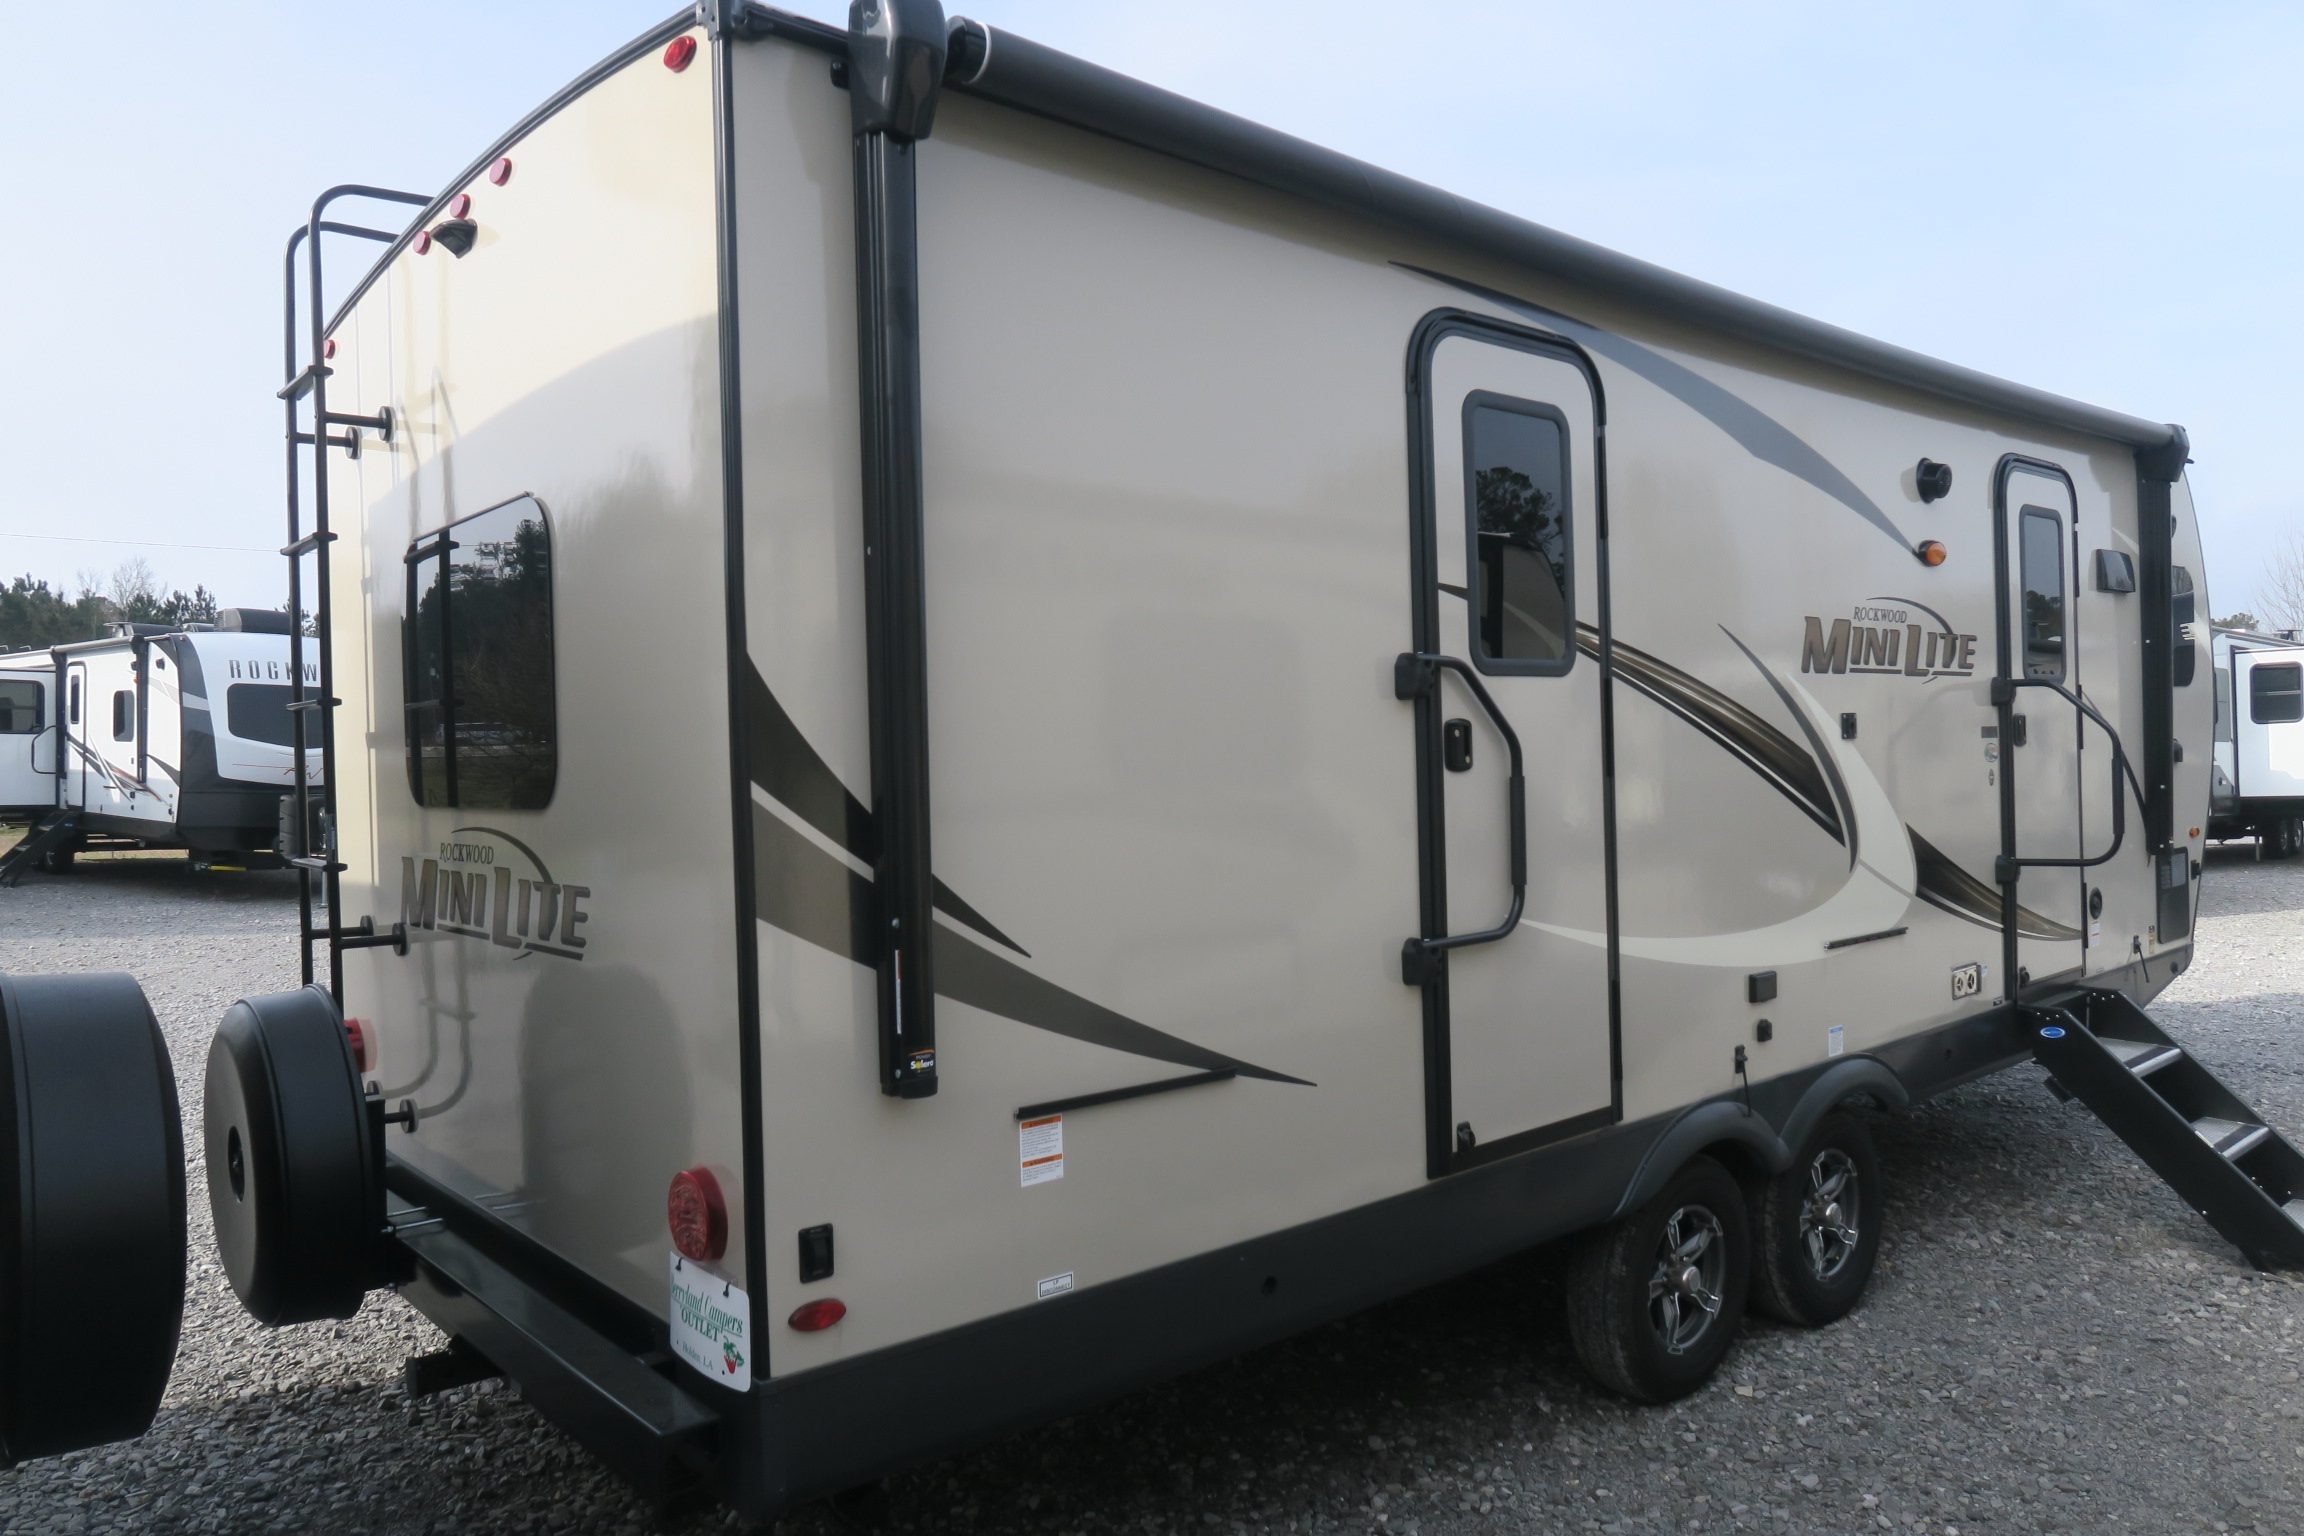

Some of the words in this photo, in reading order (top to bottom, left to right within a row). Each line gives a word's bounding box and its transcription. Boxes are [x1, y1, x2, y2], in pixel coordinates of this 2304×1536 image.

[1853, 606, 1907, 624] ROCKWOOD
[439, 842, 495, 865] ROCKWOOD
[681, 1306, 720, 1342] OUTLET
[704, 1295, 743, 1334] Campers
